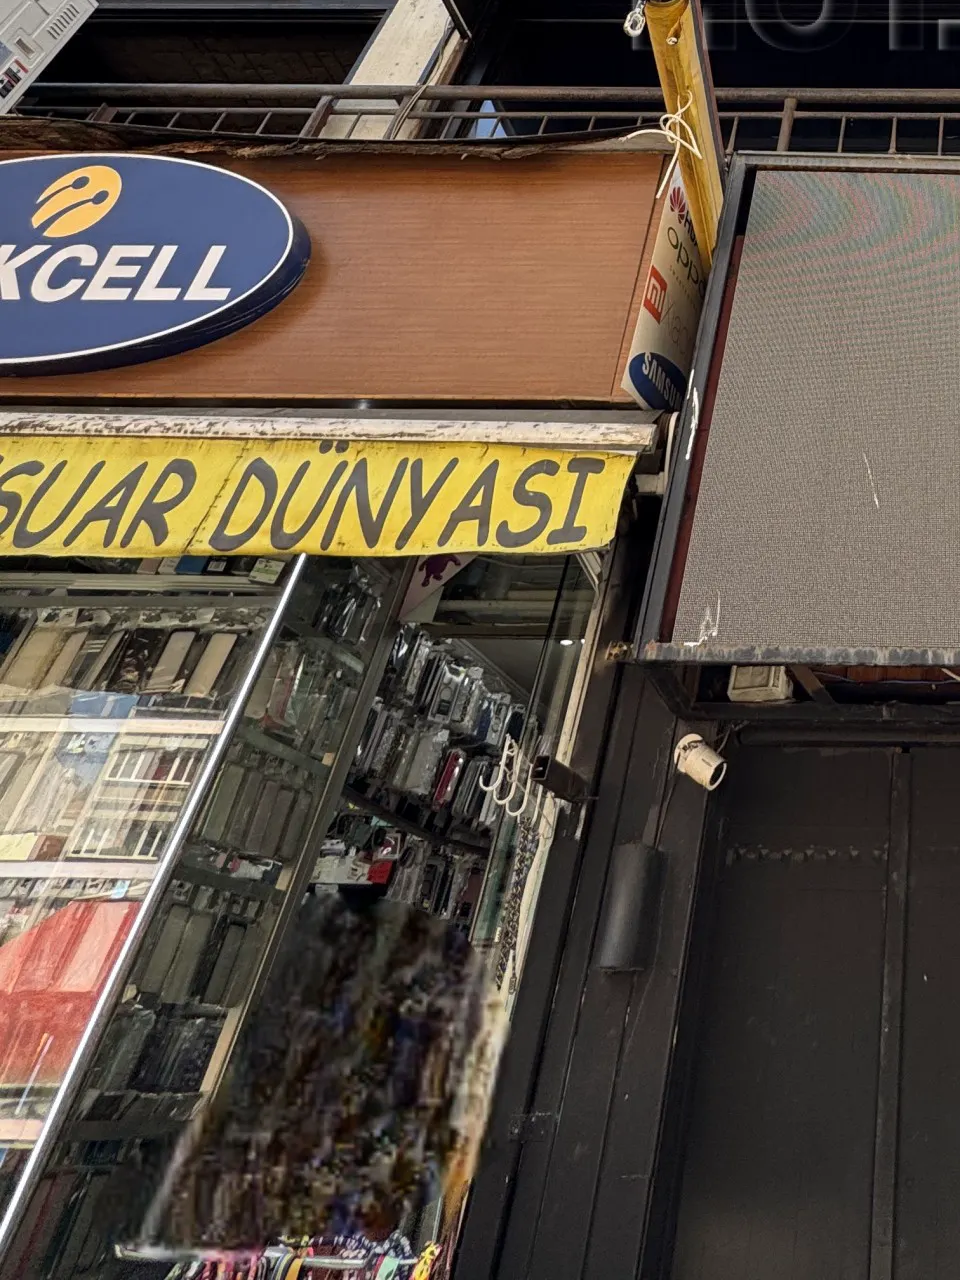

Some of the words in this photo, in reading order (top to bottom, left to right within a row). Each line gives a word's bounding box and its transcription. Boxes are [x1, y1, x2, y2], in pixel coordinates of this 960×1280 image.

[0, 243, 231, 303] KCELL
[641, 351, 683, 410] SAMSUN
[208, 439, 606, 552] DÜNYASI
